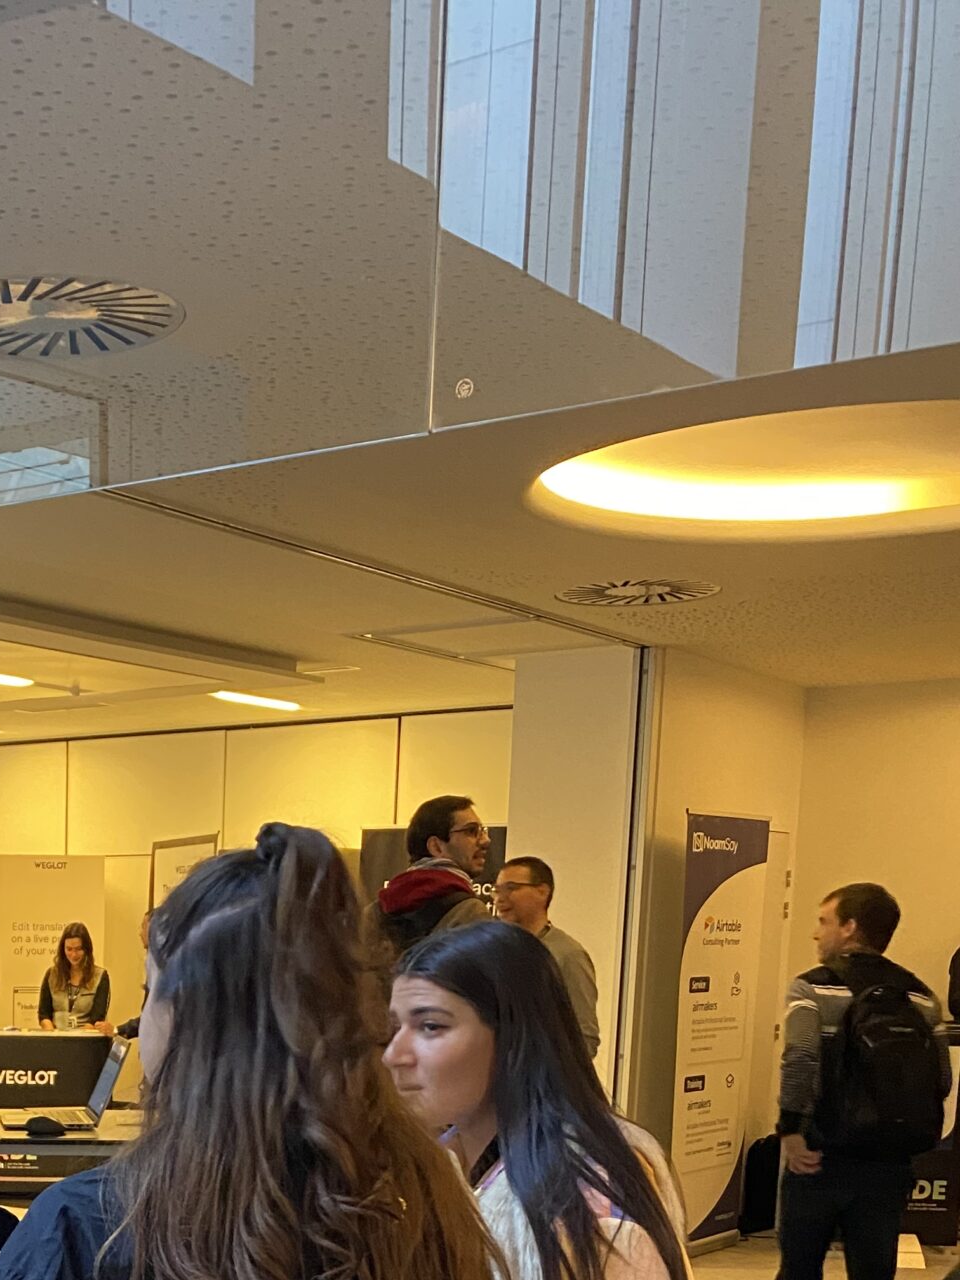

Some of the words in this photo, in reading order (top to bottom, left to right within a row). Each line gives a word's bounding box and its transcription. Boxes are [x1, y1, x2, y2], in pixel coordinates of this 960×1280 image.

[34, 861, 68, 870] WEGLOT
[12, 921, 29, 932] Edit
[11, 935, 23, 944] on
[25, 936, 31, 944] a
[33, 934, 49, 944] live
[14, 945, 23, 955] of
[26, 948, 45, 958] your
